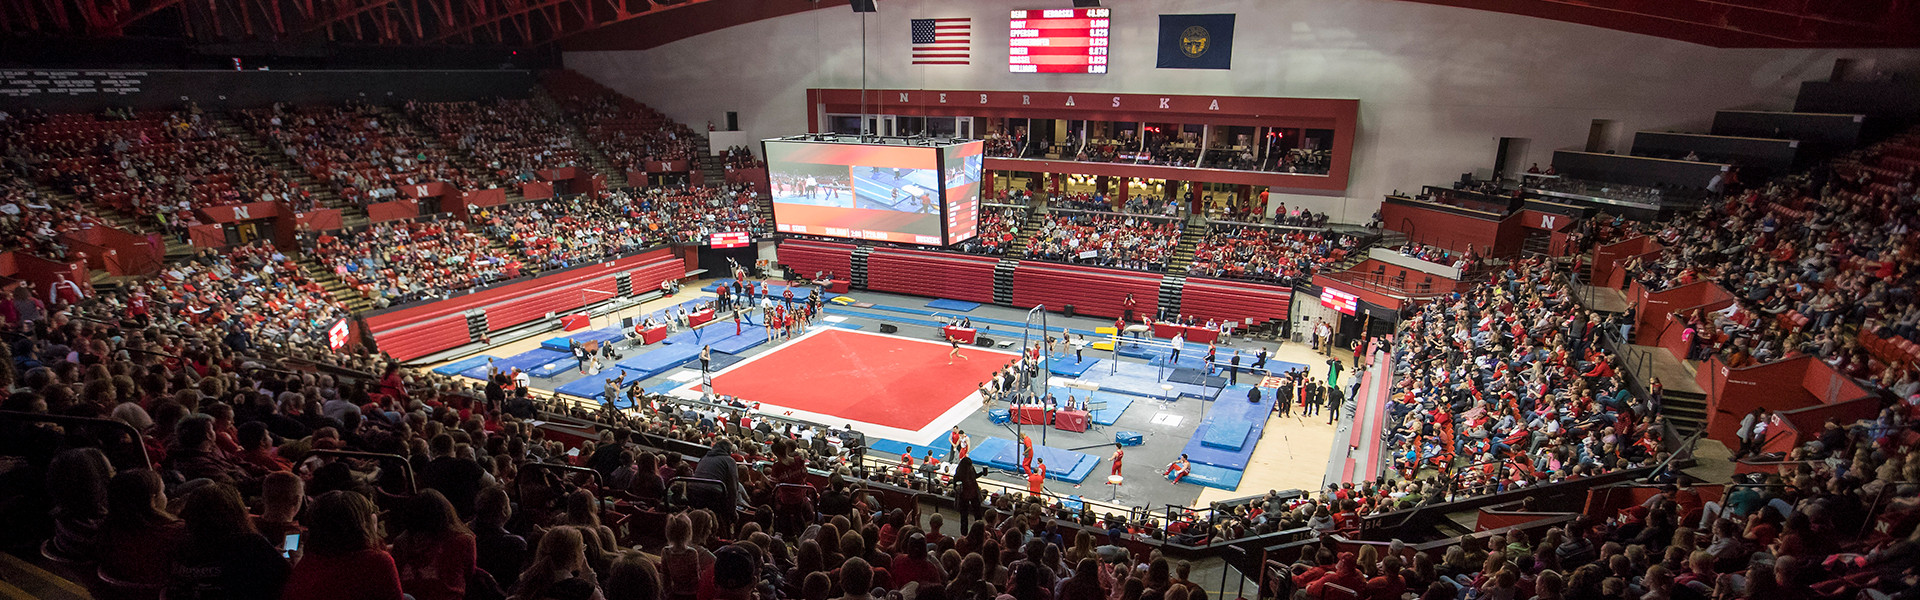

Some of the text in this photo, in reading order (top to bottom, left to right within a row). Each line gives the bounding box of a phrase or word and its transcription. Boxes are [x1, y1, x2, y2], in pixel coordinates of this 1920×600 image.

[900, 92, 1219, 110] NEBRASKA
[661, 162, 672, 171] N
[416, 185, 429, 197] N
[232, 206, 250, 220] N
[1541, 214, 1555, 229] N
[1874, 520, 1890, 534] N
